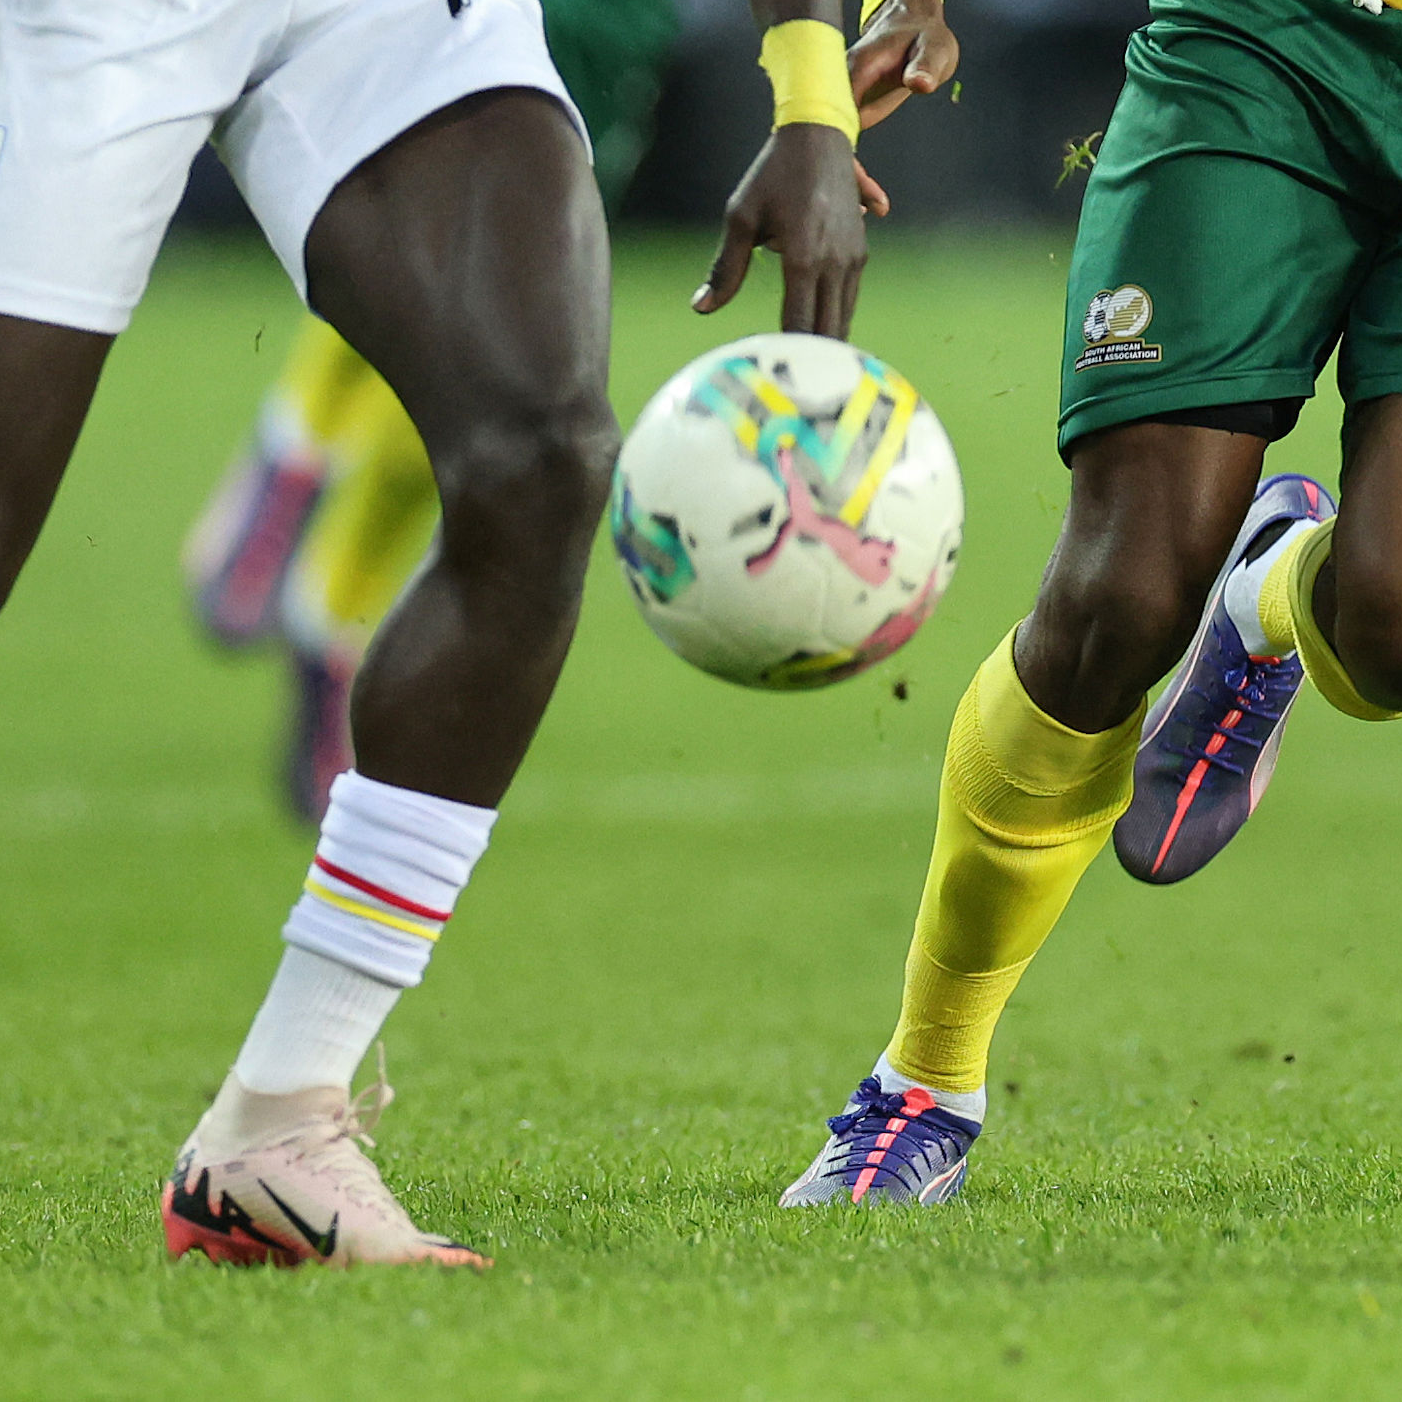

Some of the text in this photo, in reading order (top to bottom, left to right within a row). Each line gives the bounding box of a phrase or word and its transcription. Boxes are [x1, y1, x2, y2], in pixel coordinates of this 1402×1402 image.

[1084, 342, 1141, 358] SOUTH AFRICAN
[1104, 349, 1157, 362] ASSOCIATION
